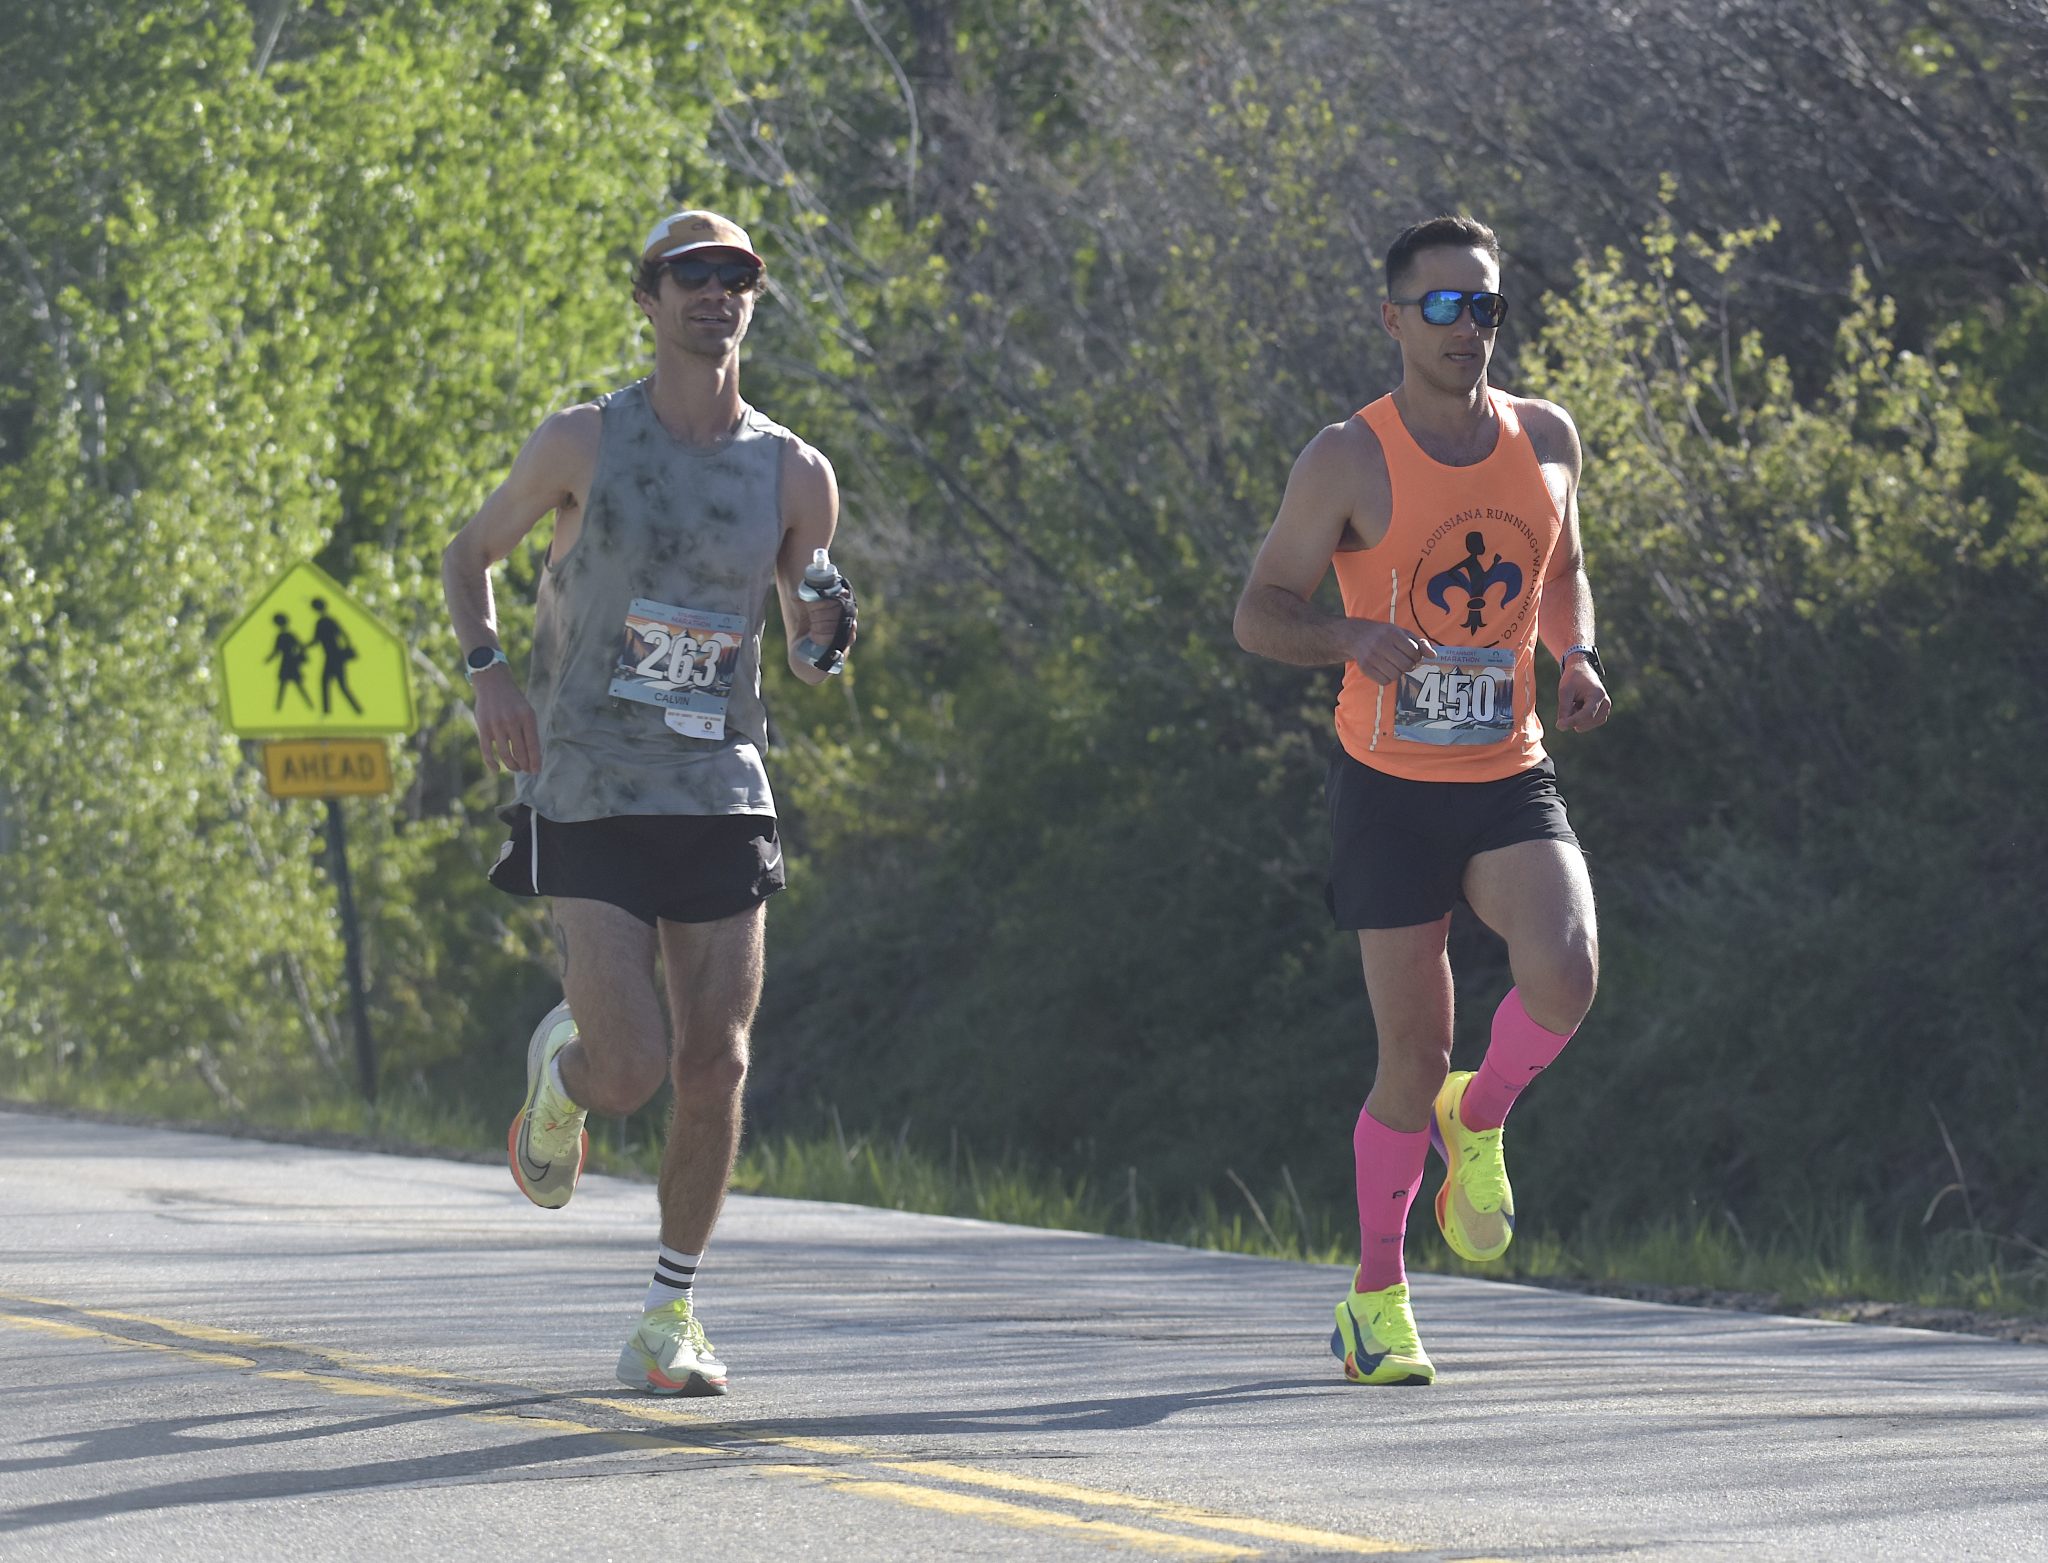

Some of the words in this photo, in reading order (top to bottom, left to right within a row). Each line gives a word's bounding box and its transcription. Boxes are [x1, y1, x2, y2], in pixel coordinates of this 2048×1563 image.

[1421, 508, 1482, 556] LOUISIANA
[1486, 508, 1538, 549] RUNNING
[636, 630, 722, 687] 263
[1440, 655, 1481, 664] MARATHON
[654, 692, 691, 706] CALVIN
[1415, 671, 1496, 722] 450
[283, 752, 376, 782] AHEAD
